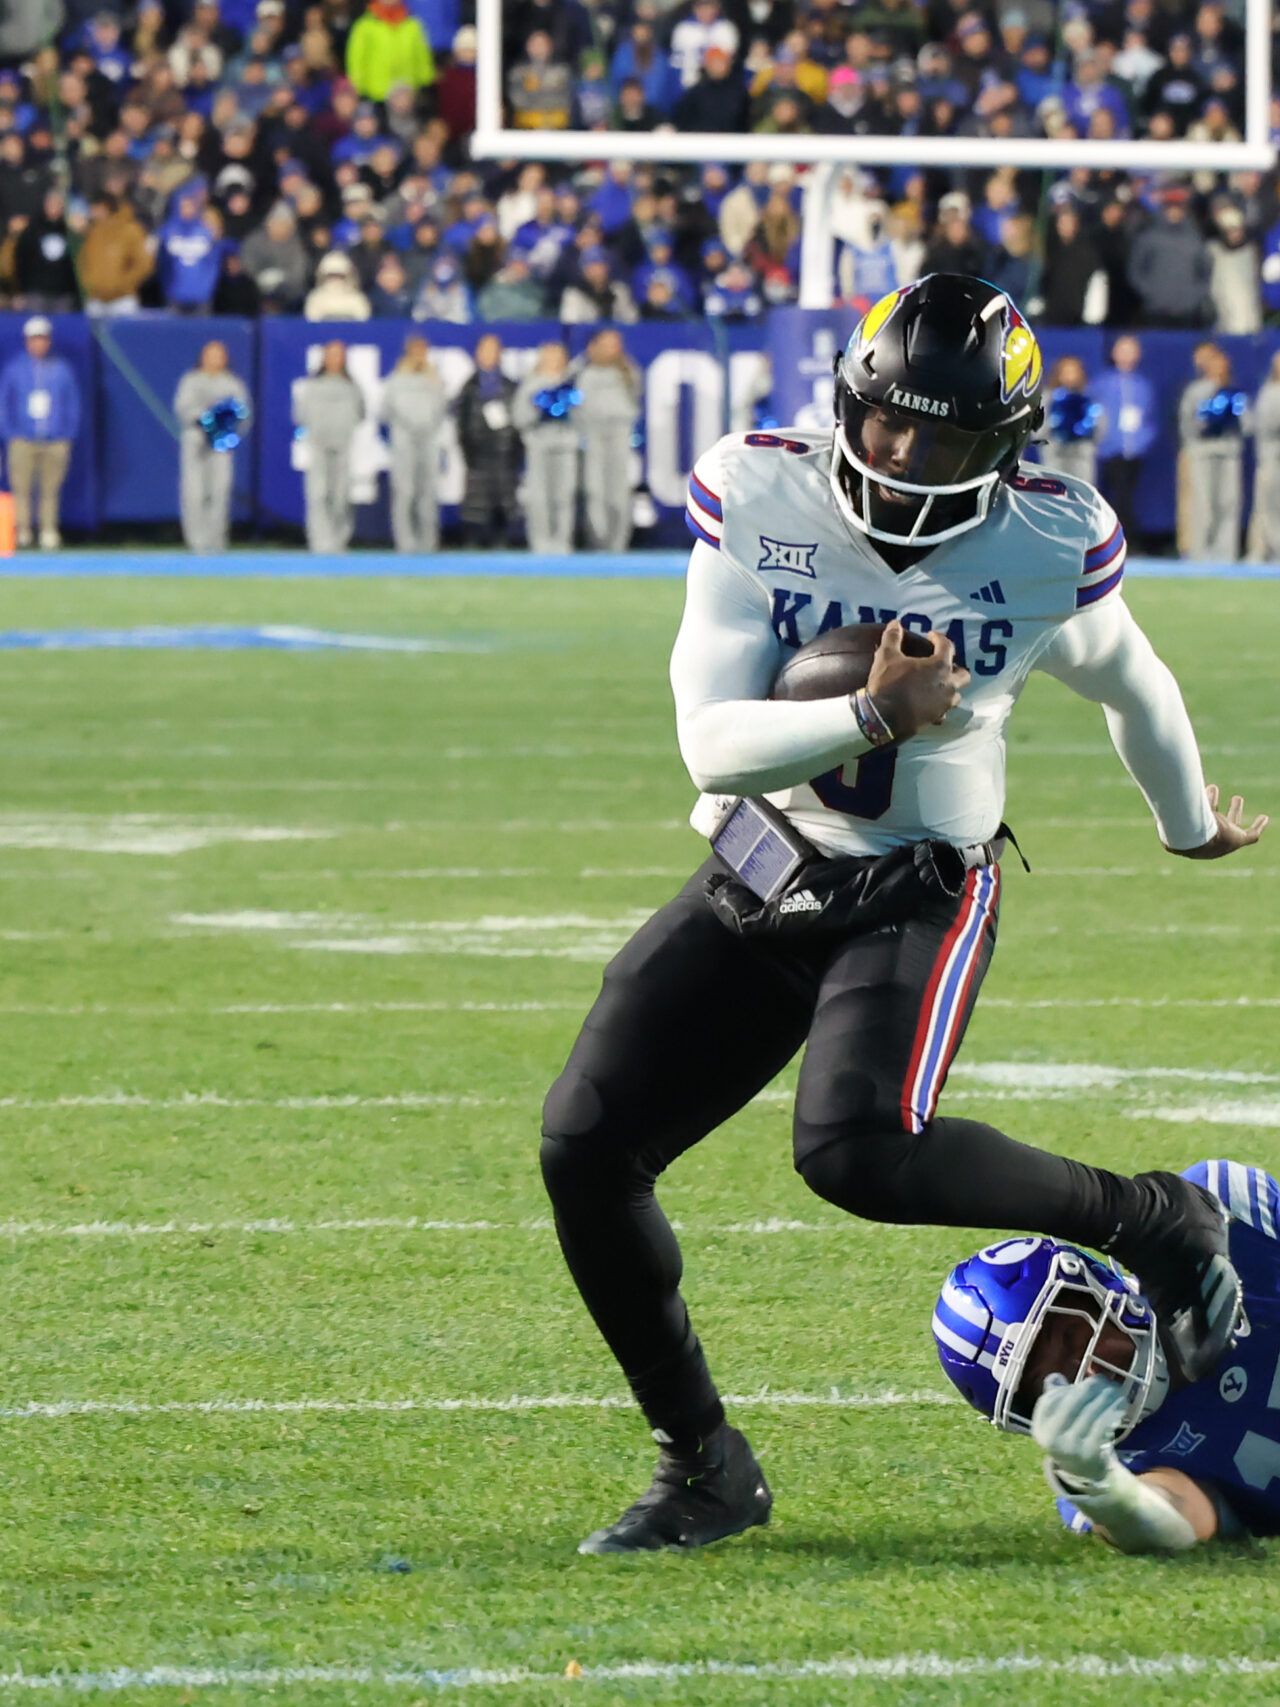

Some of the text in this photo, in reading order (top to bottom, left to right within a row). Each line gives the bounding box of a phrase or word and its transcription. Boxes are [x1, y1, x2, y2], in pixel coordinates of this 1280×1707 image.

[891, 389, 949, 417] KANSAS
[779, 899, 822, 914] adidas
[998, 1339, 1015, 1367] BYU
